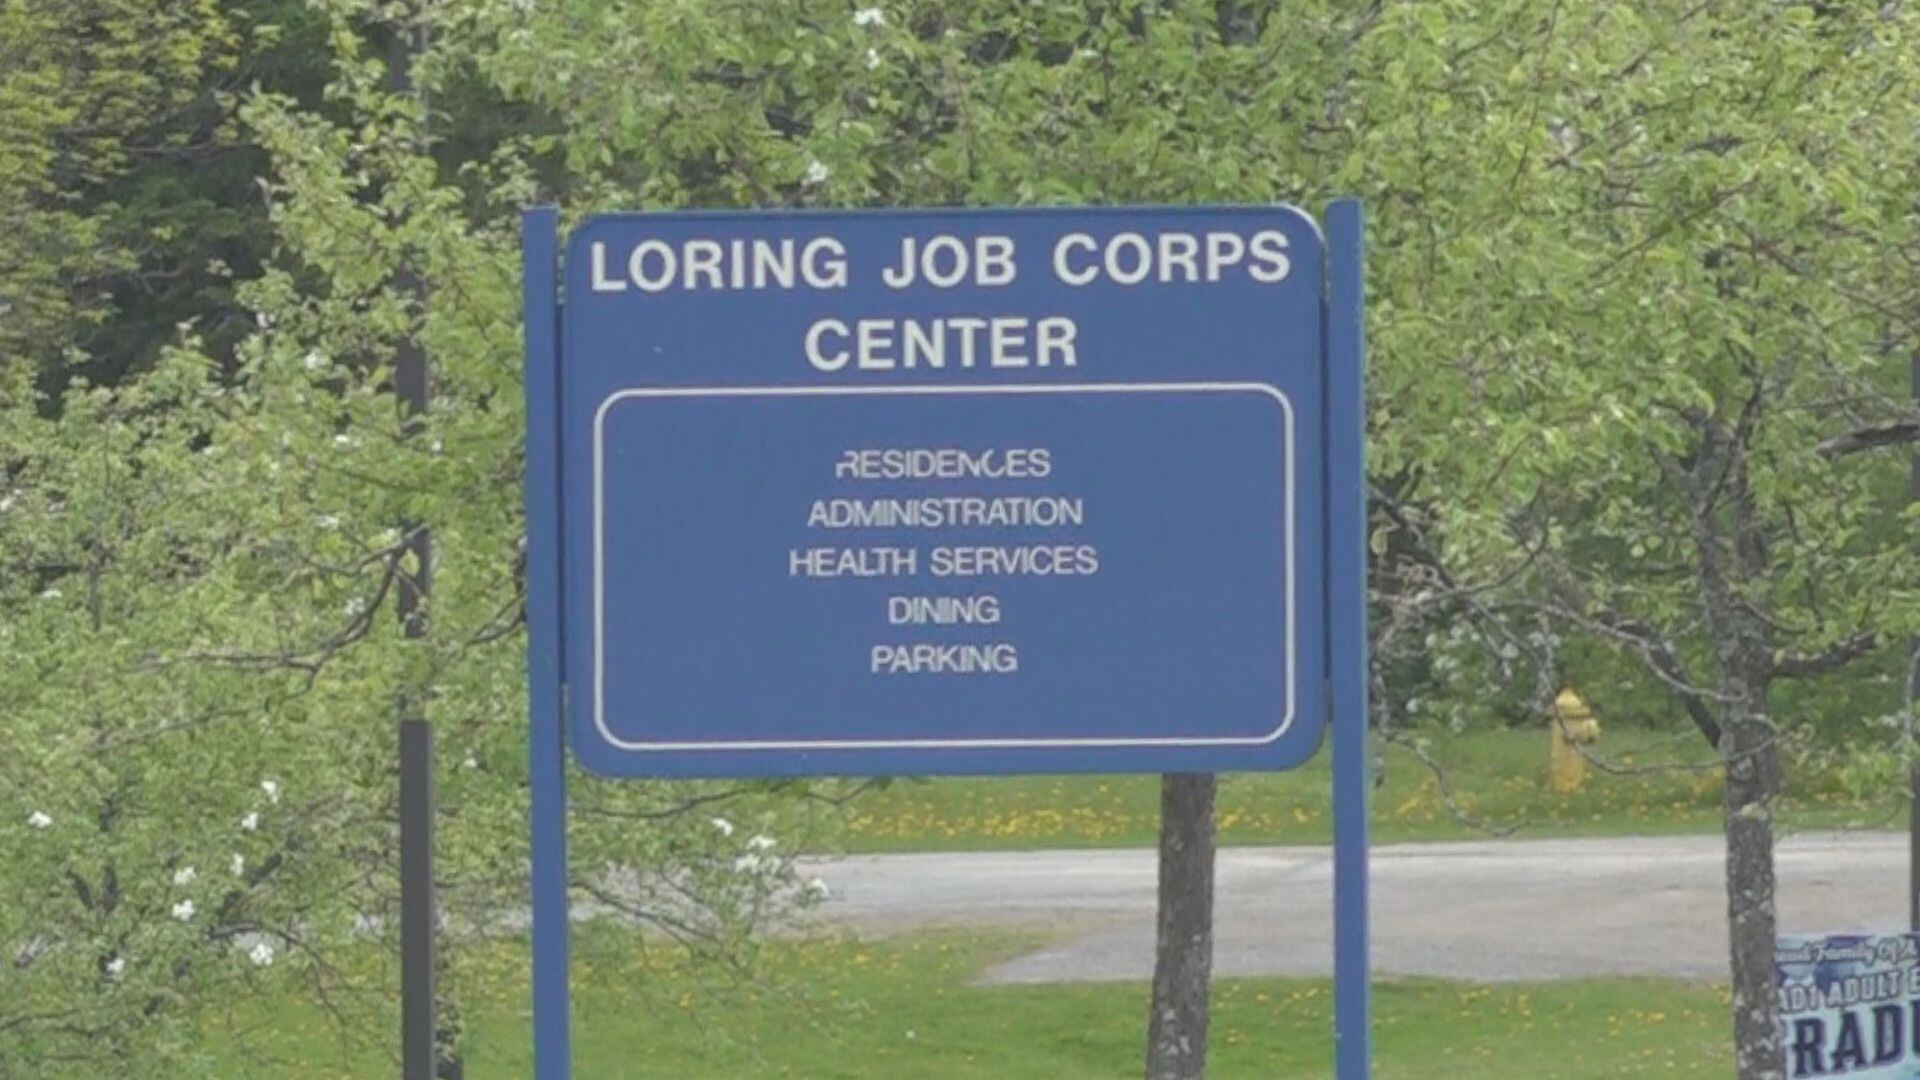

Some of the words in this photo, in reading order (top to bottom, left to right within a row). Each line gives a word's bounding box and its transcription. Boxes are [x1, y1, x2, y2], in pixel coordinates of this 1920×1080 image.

[591, 237, 848, 292] LORING
[882, 235, 1017, 289] JOB
[1053, 230, 1291, 286] CORPS
[804, 316, 1077, 371] CENTER
[836, 448, 1051, 479] RESIDENCES
[807, 497, 1083, 528] ADMINISTRATION
[789, 547, 916, 577] HEALTH
[930, 545, 1098, 576] SERVICES
[888, 595, 1000, 625] DINING
[871, 644, 1018, 673] PARKING
[1828, 971, 1899, 1007] ADULT
